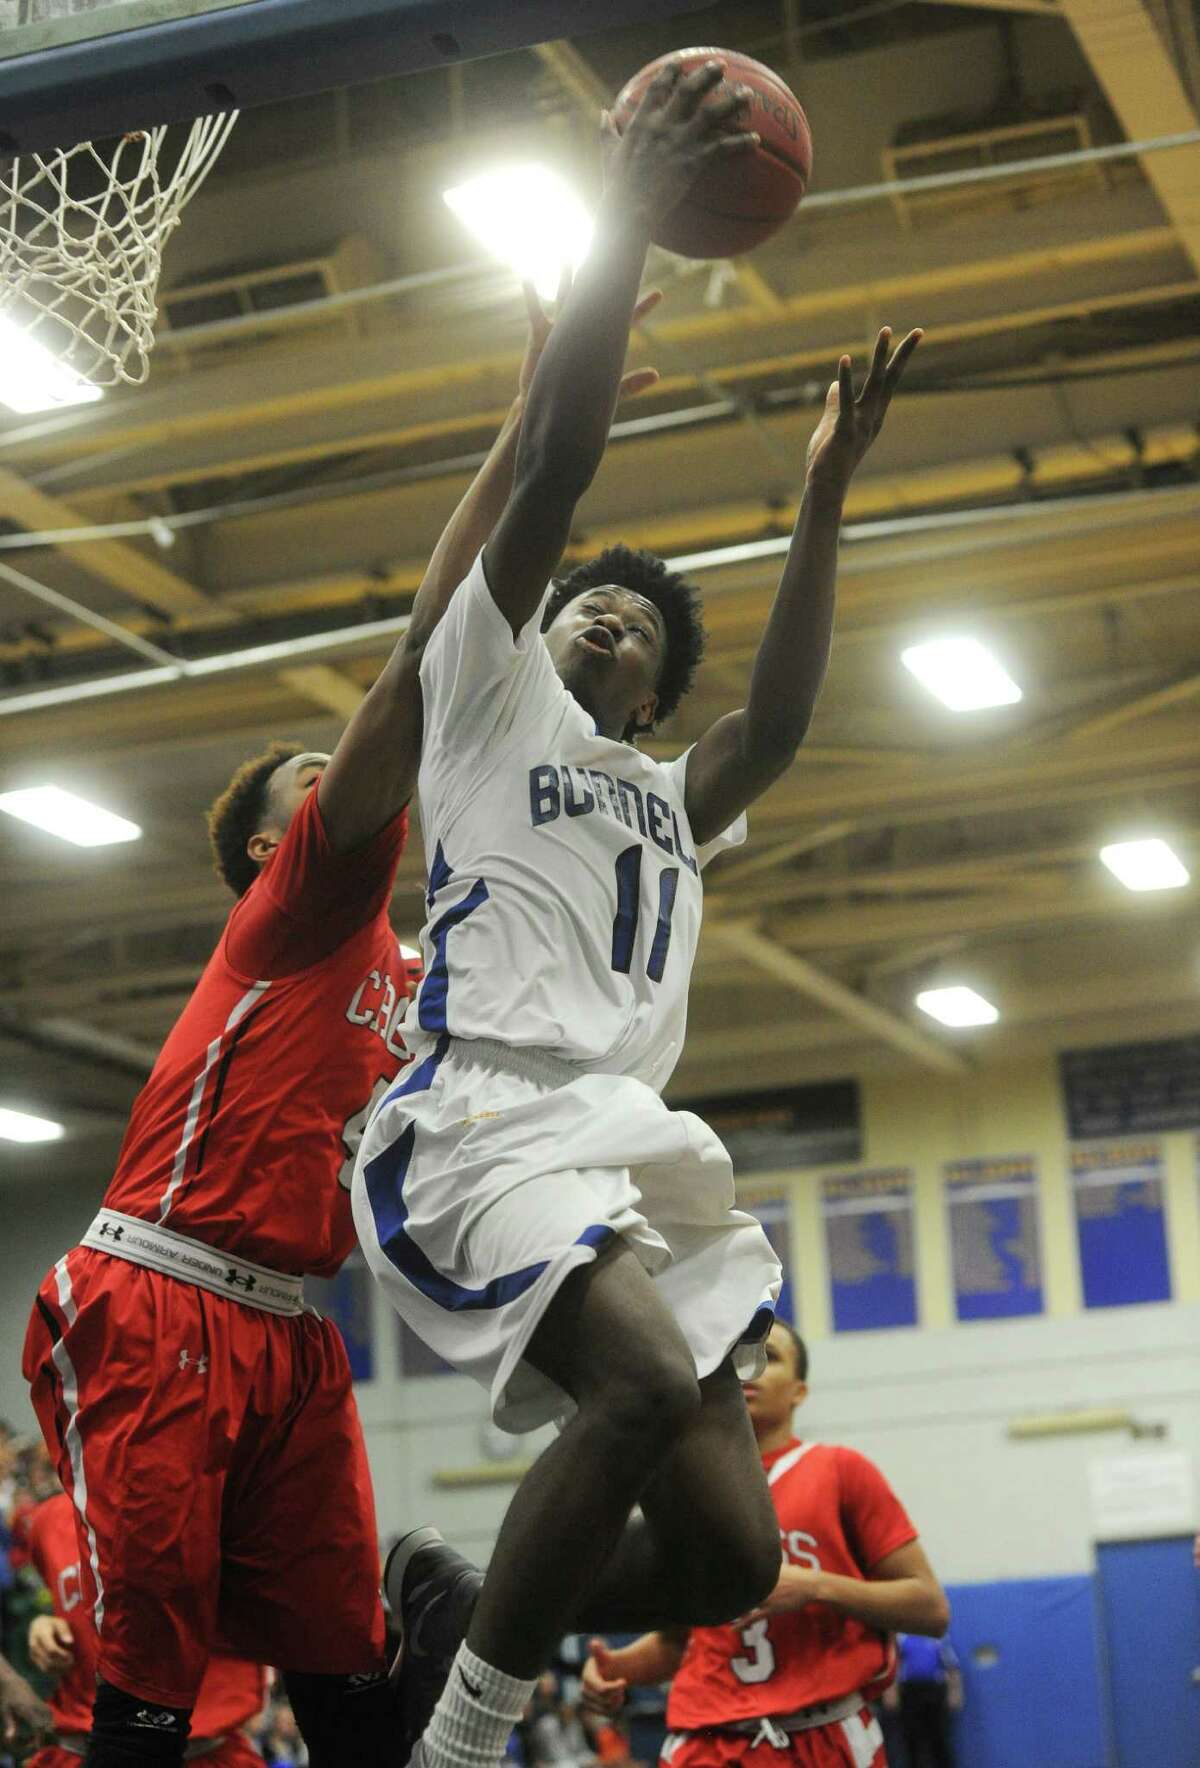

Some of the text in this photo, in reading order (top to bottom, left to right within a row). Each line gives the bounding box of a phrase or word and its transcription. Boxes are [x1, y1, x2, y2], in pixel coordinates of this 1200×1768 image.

[611, 844, 680, 984] 11
[127, 1235, 223, 1277] UNDER ARMOUR
[729, 1615, 775, 1684] 3
